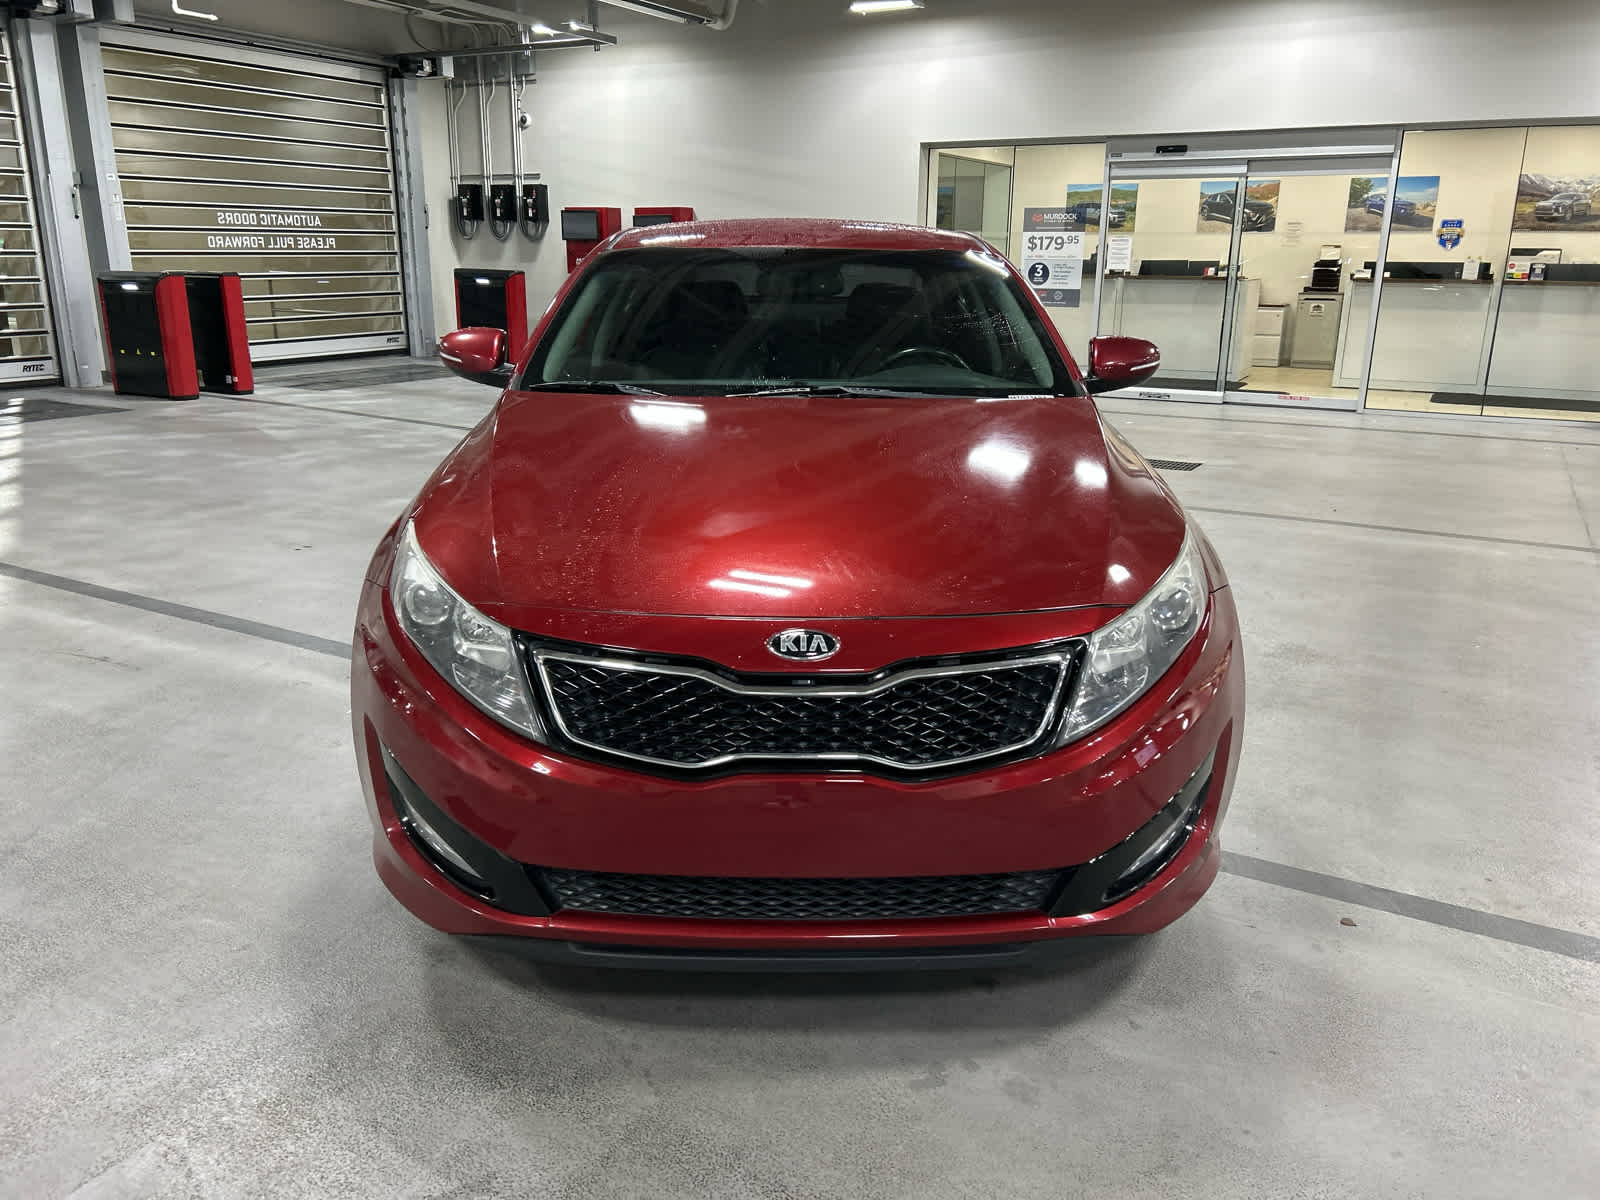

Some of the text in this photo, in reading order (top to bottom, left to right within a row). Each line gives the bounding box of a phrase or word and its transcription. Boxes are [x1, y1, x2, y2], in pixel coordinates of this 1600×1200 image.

[1034, 264, 1043, 277] 3
[22, 364, 45, 373] RYTEC
[780, 633, 829, 652] KIA
